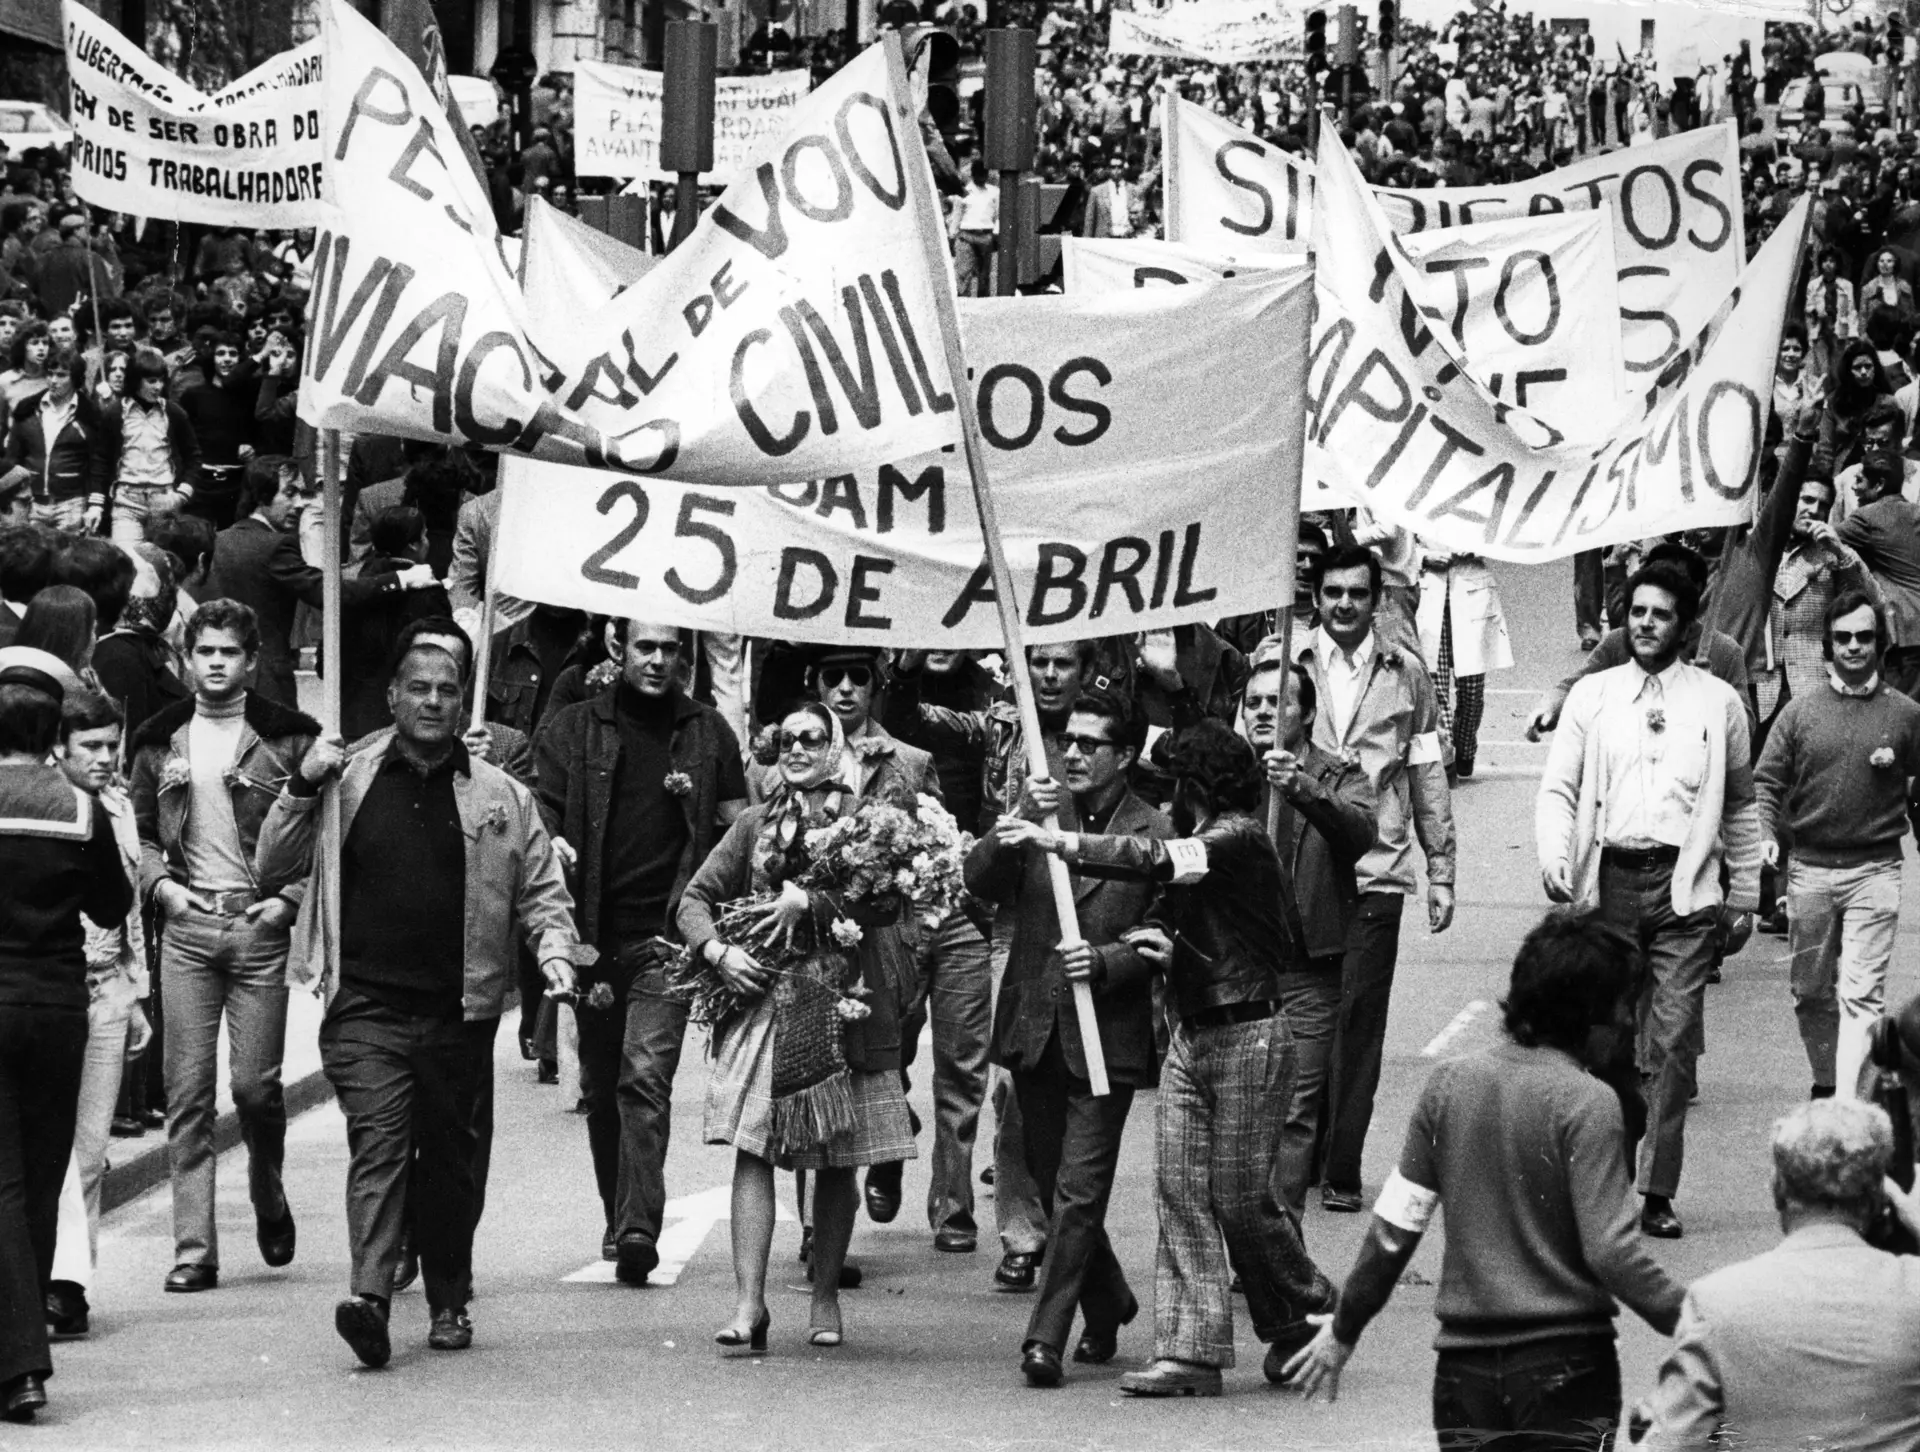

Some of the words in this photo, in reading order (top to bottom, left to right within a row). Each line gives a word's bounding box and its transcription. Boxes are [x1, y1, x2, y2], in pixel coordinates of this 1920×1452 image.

[107, 105, 136, 133] DE
[148, 117, 199, 144] SER
[213, 118, 278, 149] OBRA
[293, 109, 319, 141] DO
[585, 136, 656, 162] AVANT
[711, 90, 906, 260] VOO
[147, 156, 323, 204] TRABALHADORE
[681, 259, 749, 338] DE
[729, 268, 956, 457] CIVIL
[966, 356, 1113, 452] OS
[1306, 316, 1762, 549] APITALISMO
[580, 480, 738, 605] 25
[772, 547, 896, 630] DE
[940, 522, 1219, 629] ABRIL
